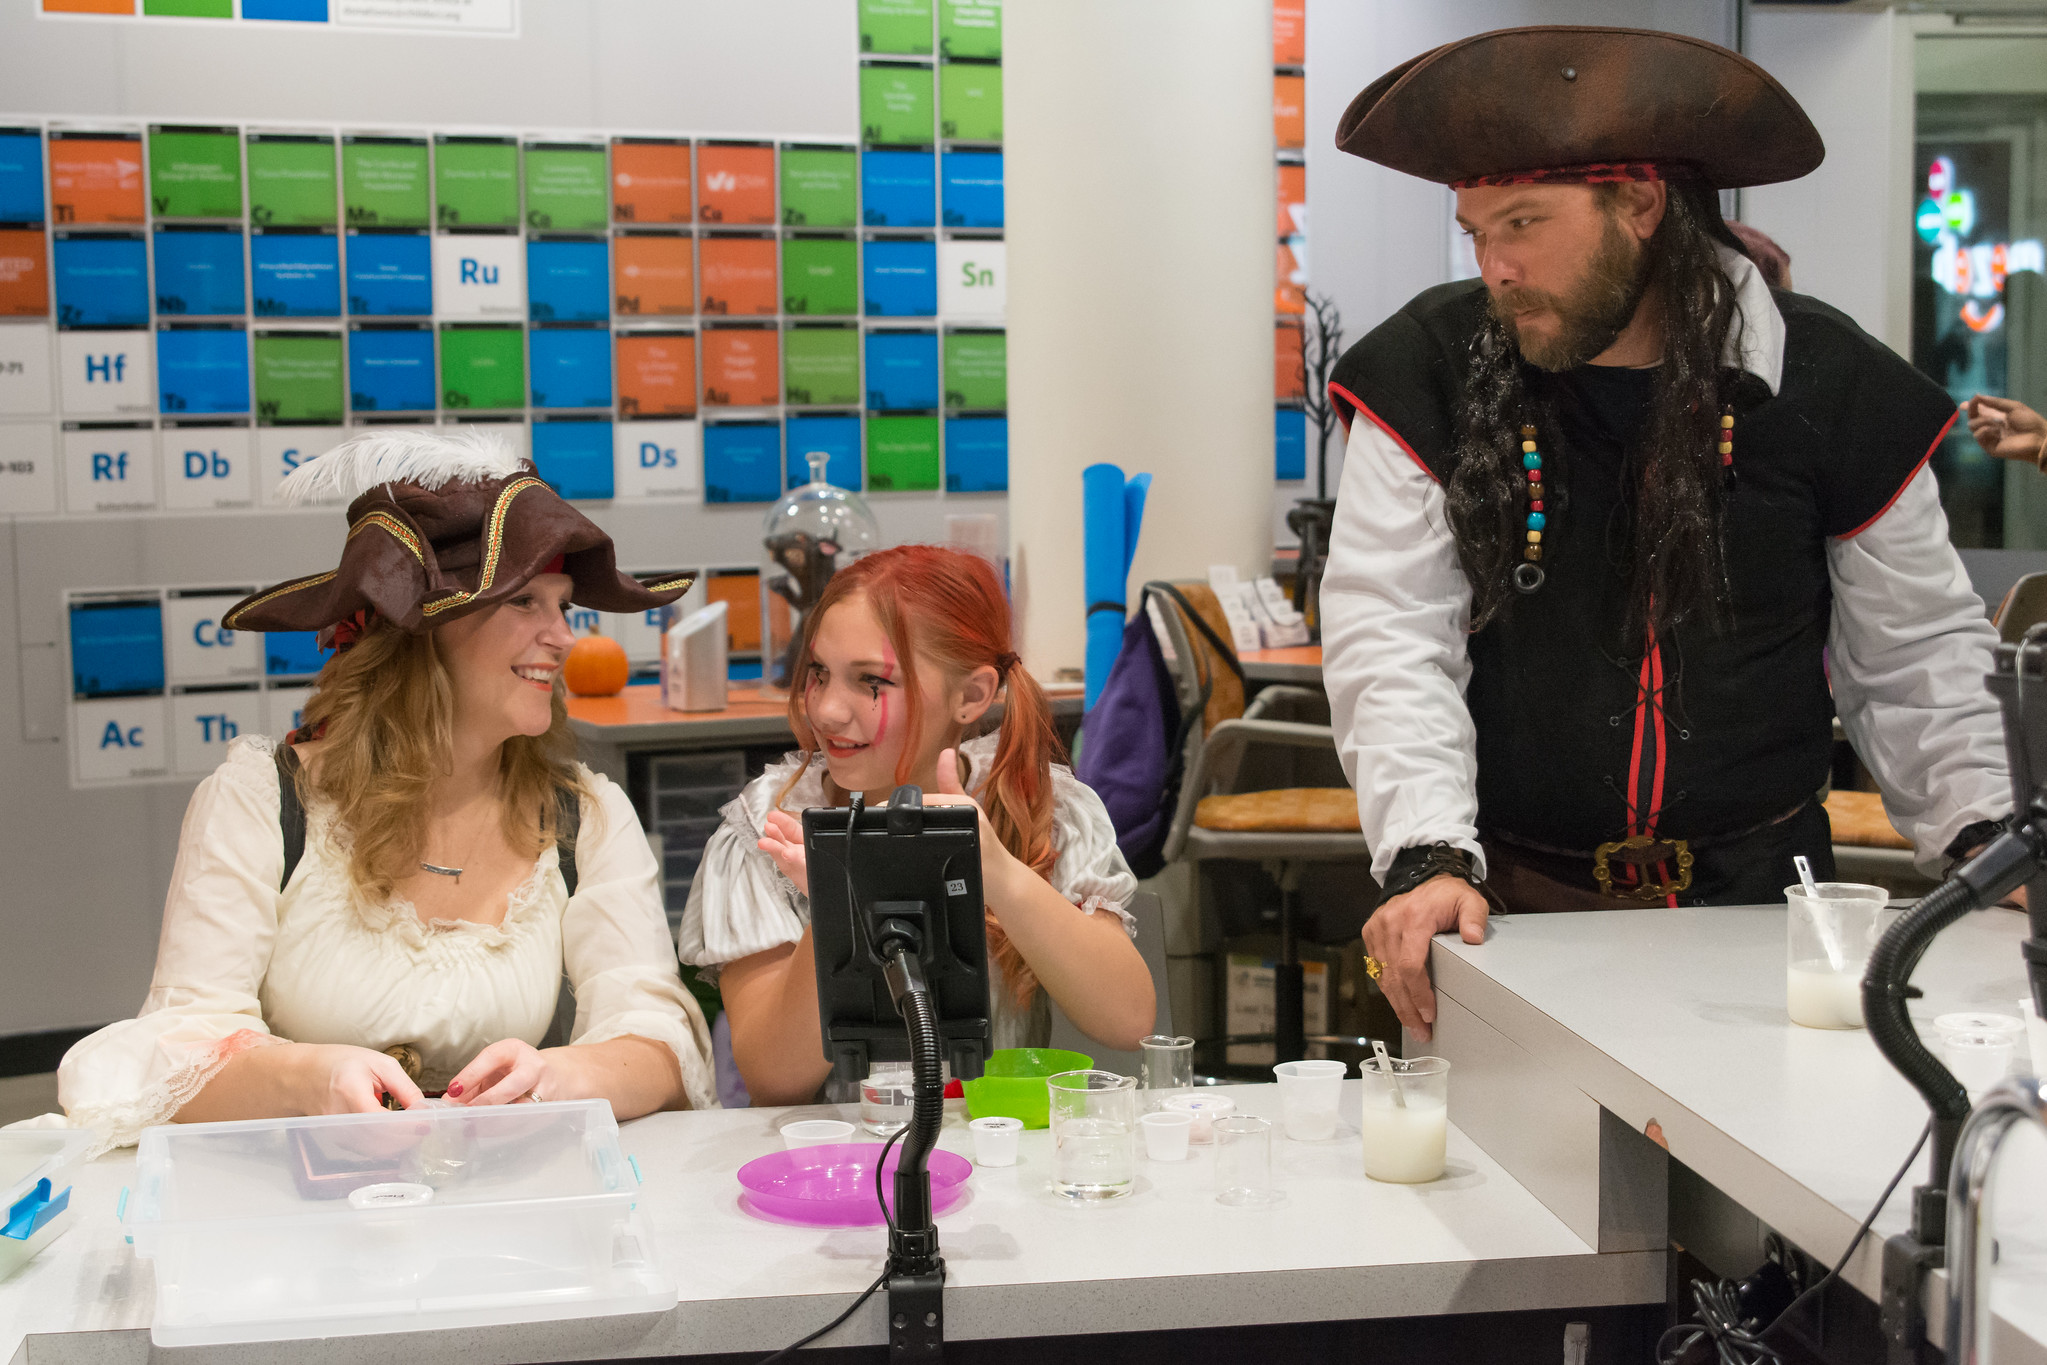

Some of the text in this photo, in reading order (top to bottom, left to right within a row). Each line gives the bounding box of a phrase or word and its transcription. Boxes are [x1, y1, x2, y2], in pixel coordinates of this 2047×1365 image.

[460, 257, 499, 285] Ru
[962, 261, 994, 288] Sn
[86, 353, 127, 382] Hf
[92, 451, 128, 480] Rf
[184, 450, 231, 478] Db
[639, 441, 678, 468] Ds
[193, 619, 234, 646] Ce
[100, 720, 144, 750] Ac
[195, 713, 238, 742] Th
[950, 882, 964, 892] 23
